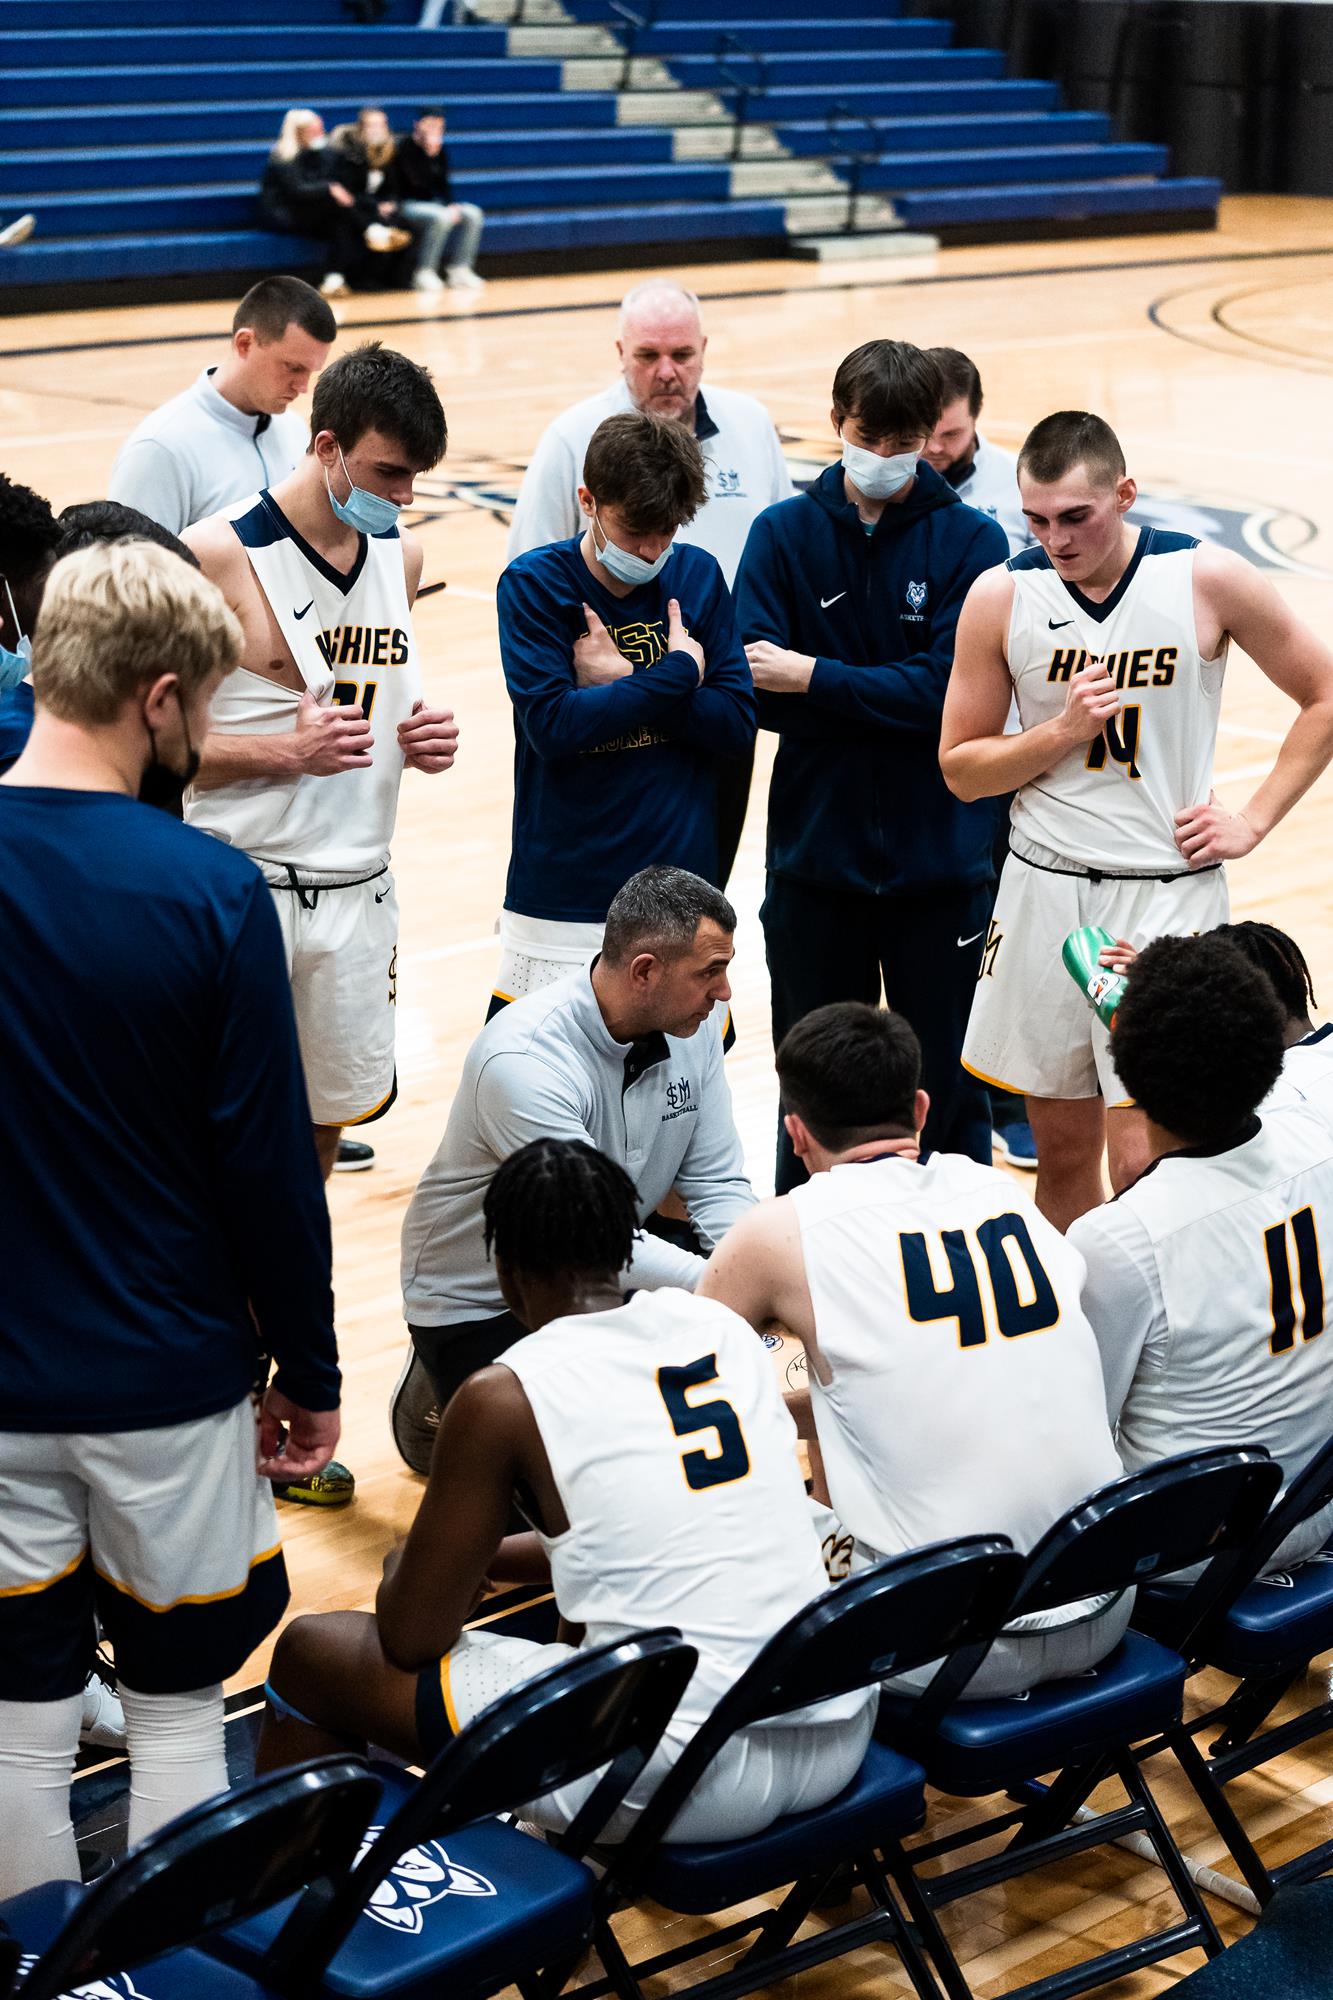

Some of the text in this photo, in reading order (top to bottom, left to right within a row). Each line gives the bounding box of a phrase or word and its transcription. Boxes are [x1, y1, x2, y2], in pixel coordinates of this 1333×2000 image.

[315, 624, 409, 671] KIES
[1046, 645, 1178, 690] HIES
[897, 1210, 1061, 1350] 40
[1263, 1203, 1326, 1357] 11
[655, 1352, 752, 1493] 5
